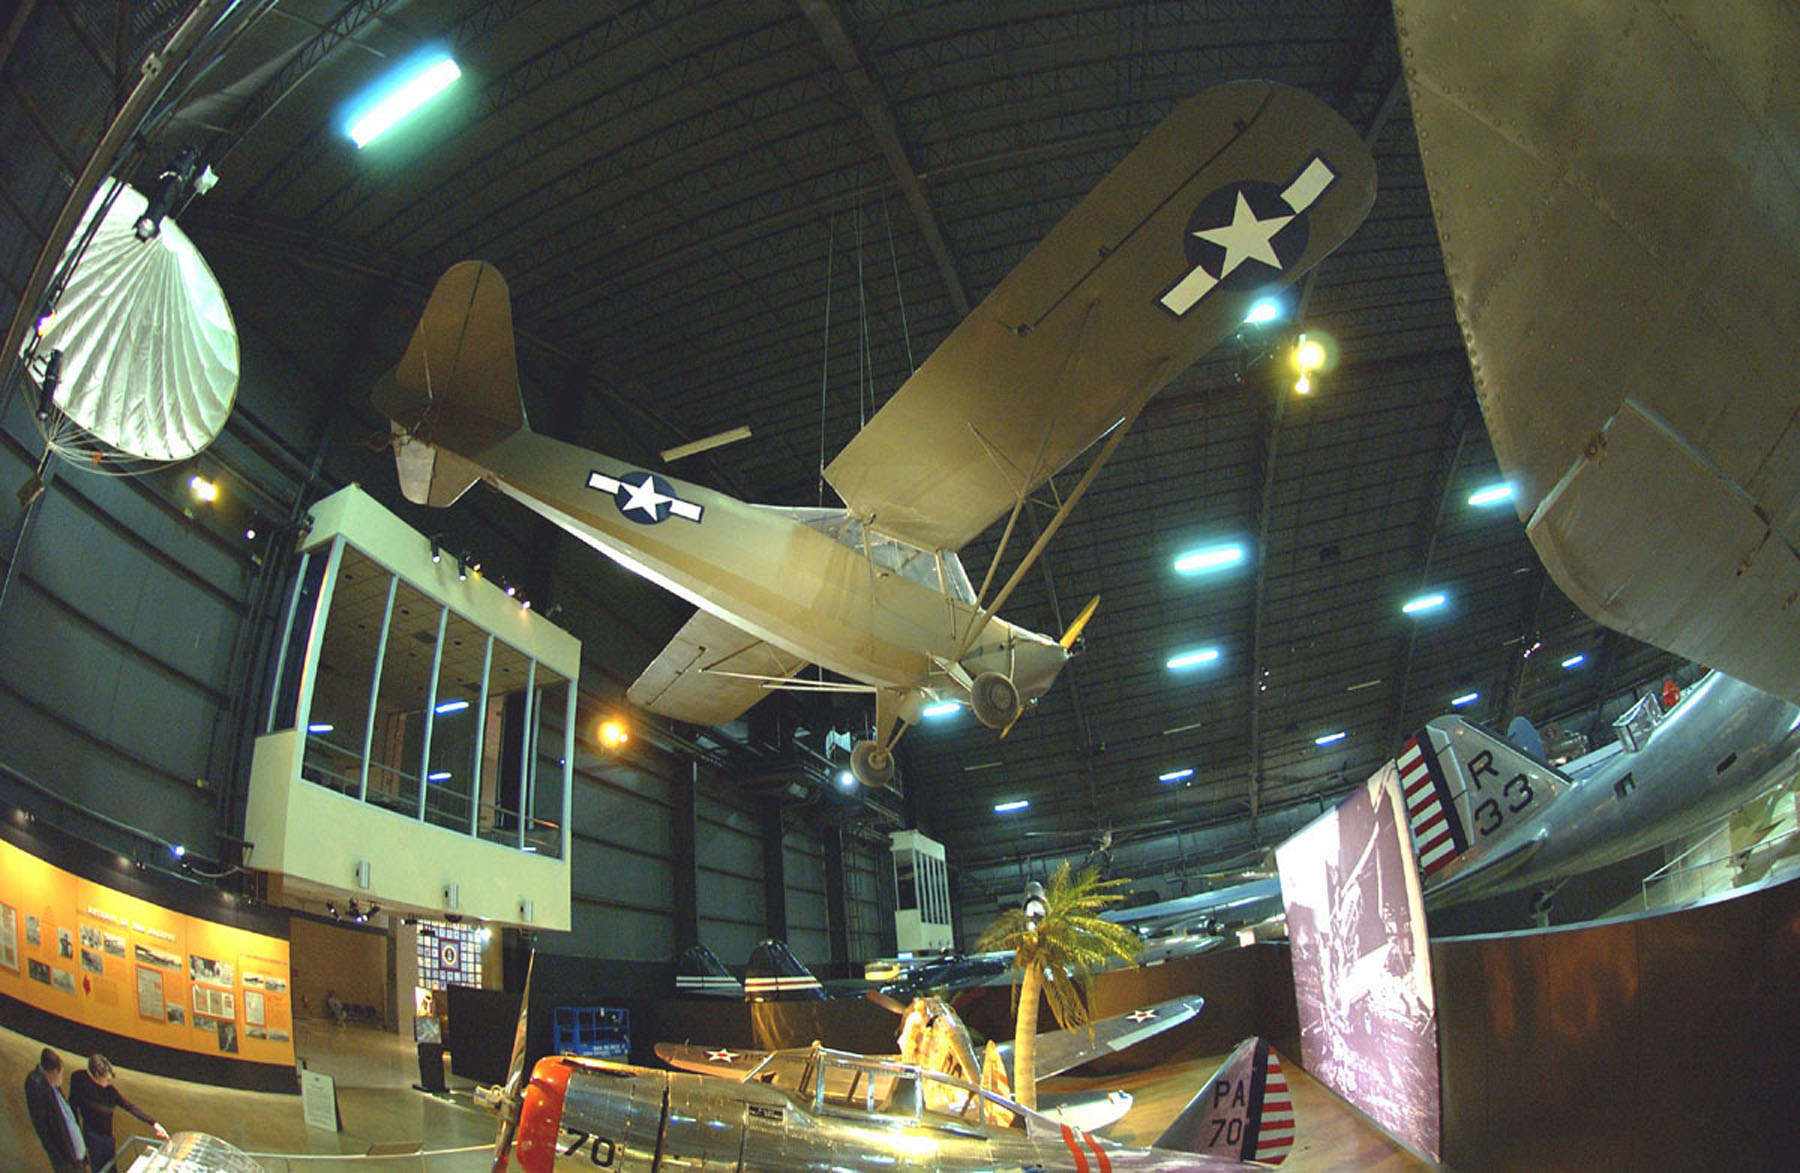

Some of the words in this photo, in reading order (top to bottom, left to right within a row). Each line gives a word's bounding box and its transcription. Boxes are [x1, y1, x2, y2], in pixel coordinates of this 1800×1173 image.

[1468, 749, 1499, 790] R
[1474, 773, 1534, 836] 33
[1214, 1080, 1245, 1109] PA
[564, 1127, 616, 1168] 70
[1208, 1118, 1242, 1147] 70
